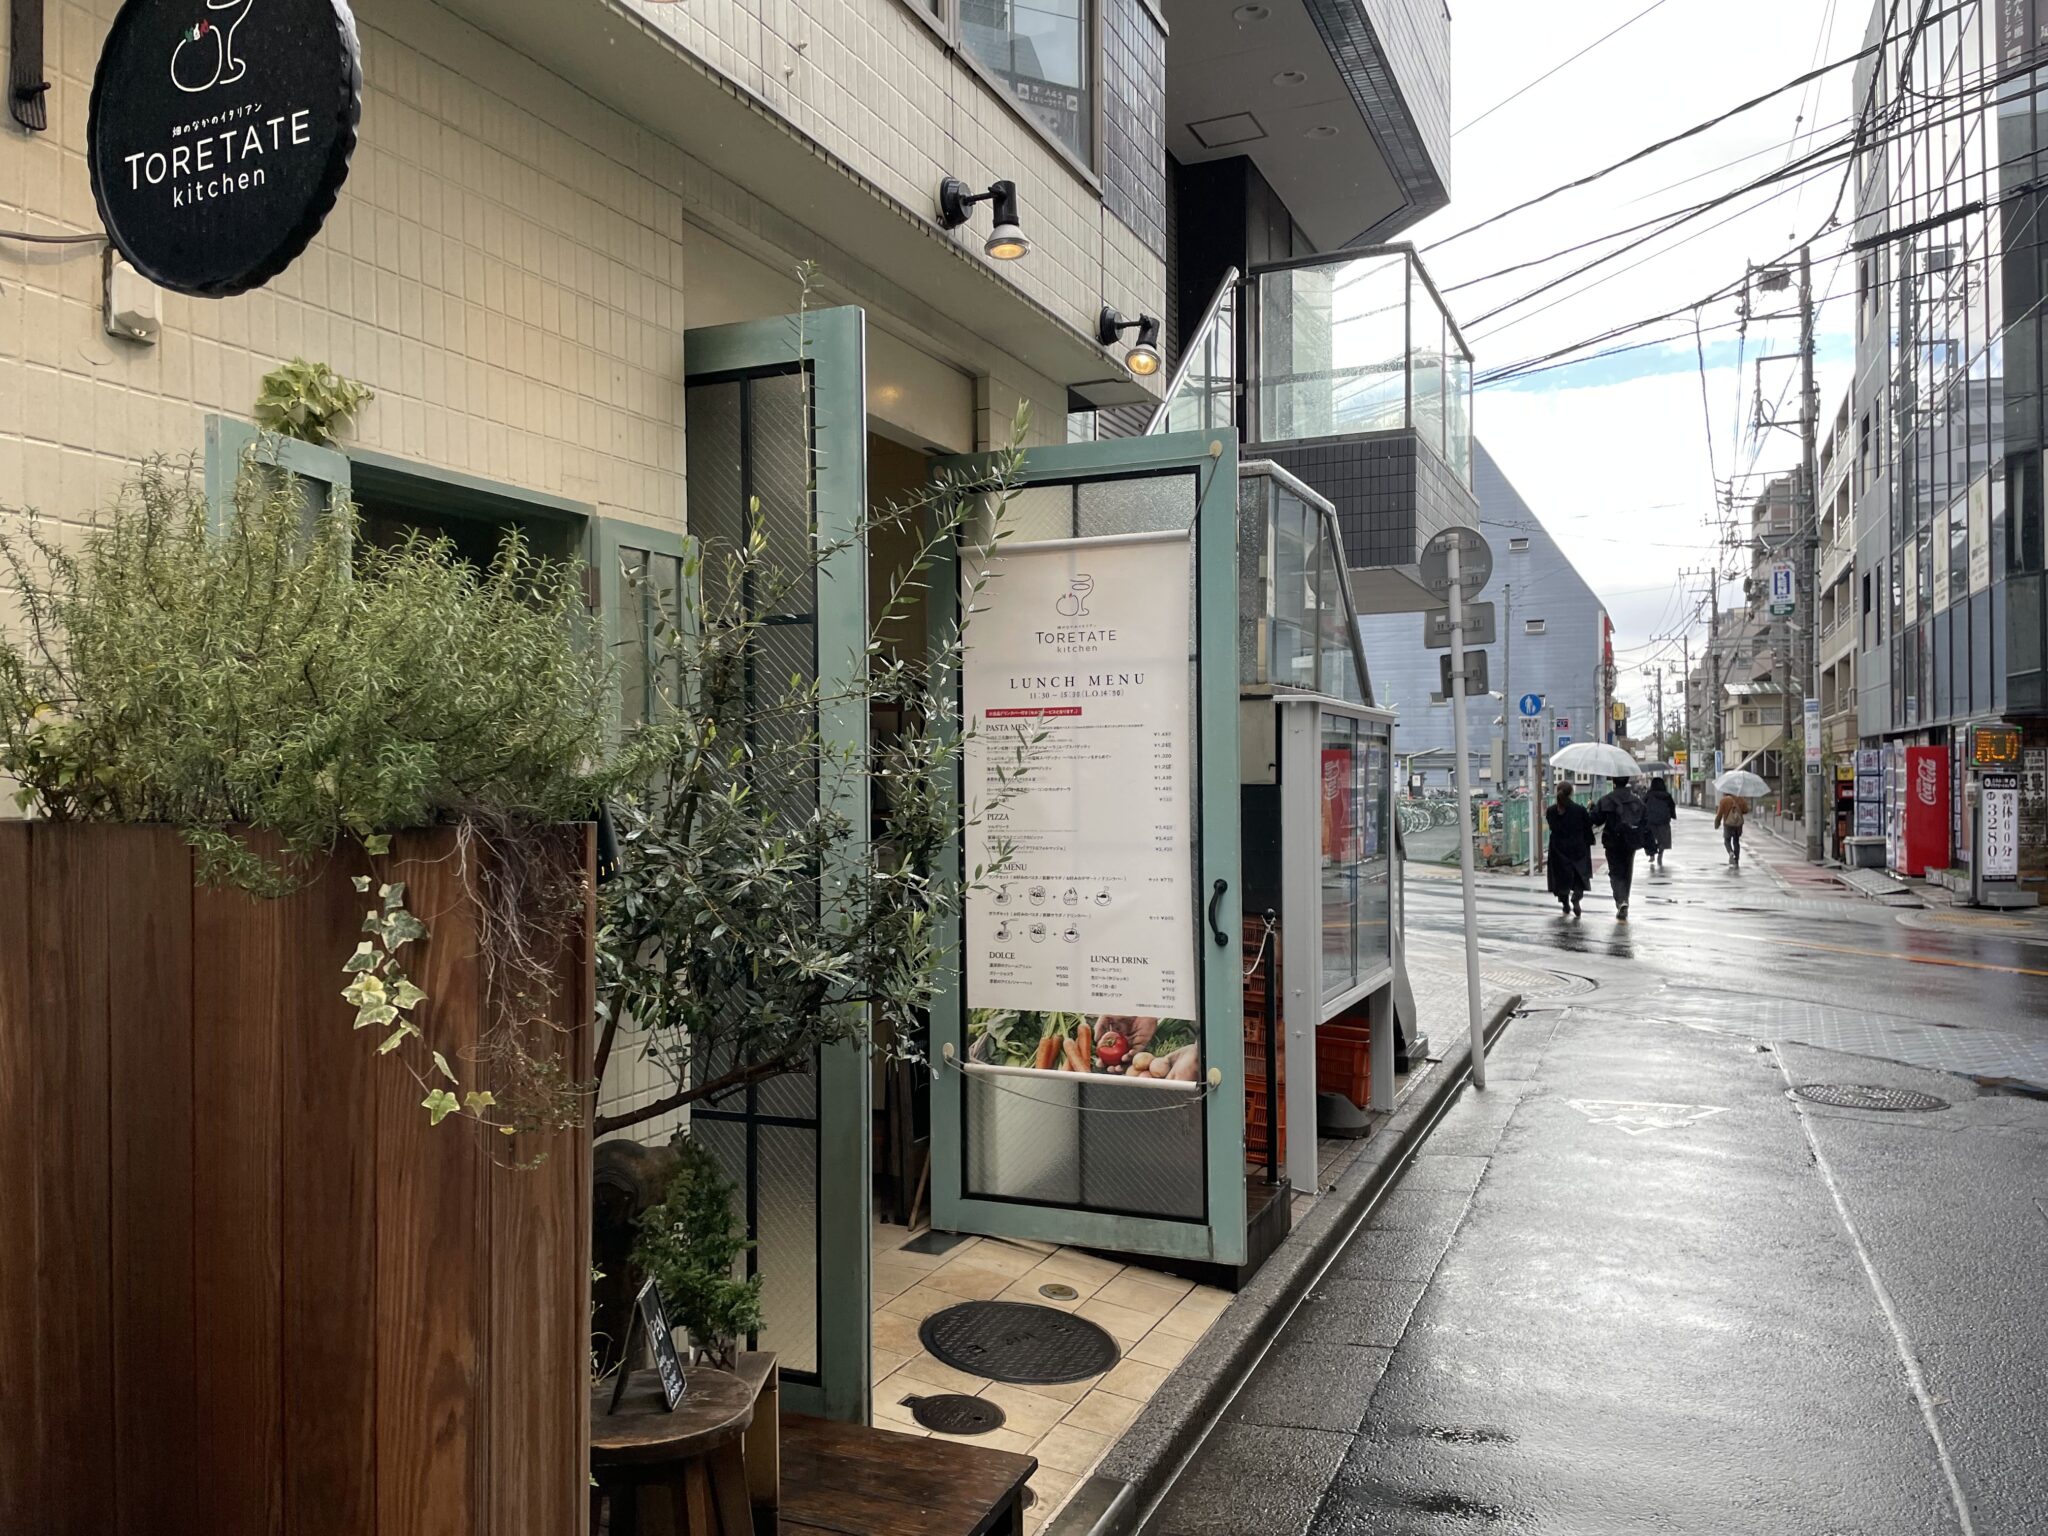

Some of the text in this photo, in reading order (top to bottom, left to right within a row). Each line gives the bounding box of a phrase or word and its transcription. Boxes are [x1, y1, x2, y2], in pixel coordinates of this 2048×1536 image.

[172, 103, 263, 137] 畑のなかのイタリアン
[125, 109, 312, 190] TORETATE
[173, 167, 266, 207] kitchen
[1035, 629, 1117, 644] TORETATE
[1057, 645, 1098, 653] kitchen
[1010, 673, 1146, 689] LUNCH MENU
[986, 724, 1009, 732] PASTA
[987, 813, 1009, 821] PIZZA
[1003, 864, 1028, 872] MENU
[989, 951, 1016, 960] DOLCE
[1090, 955, 1149, 965] LUNCH DRINK
